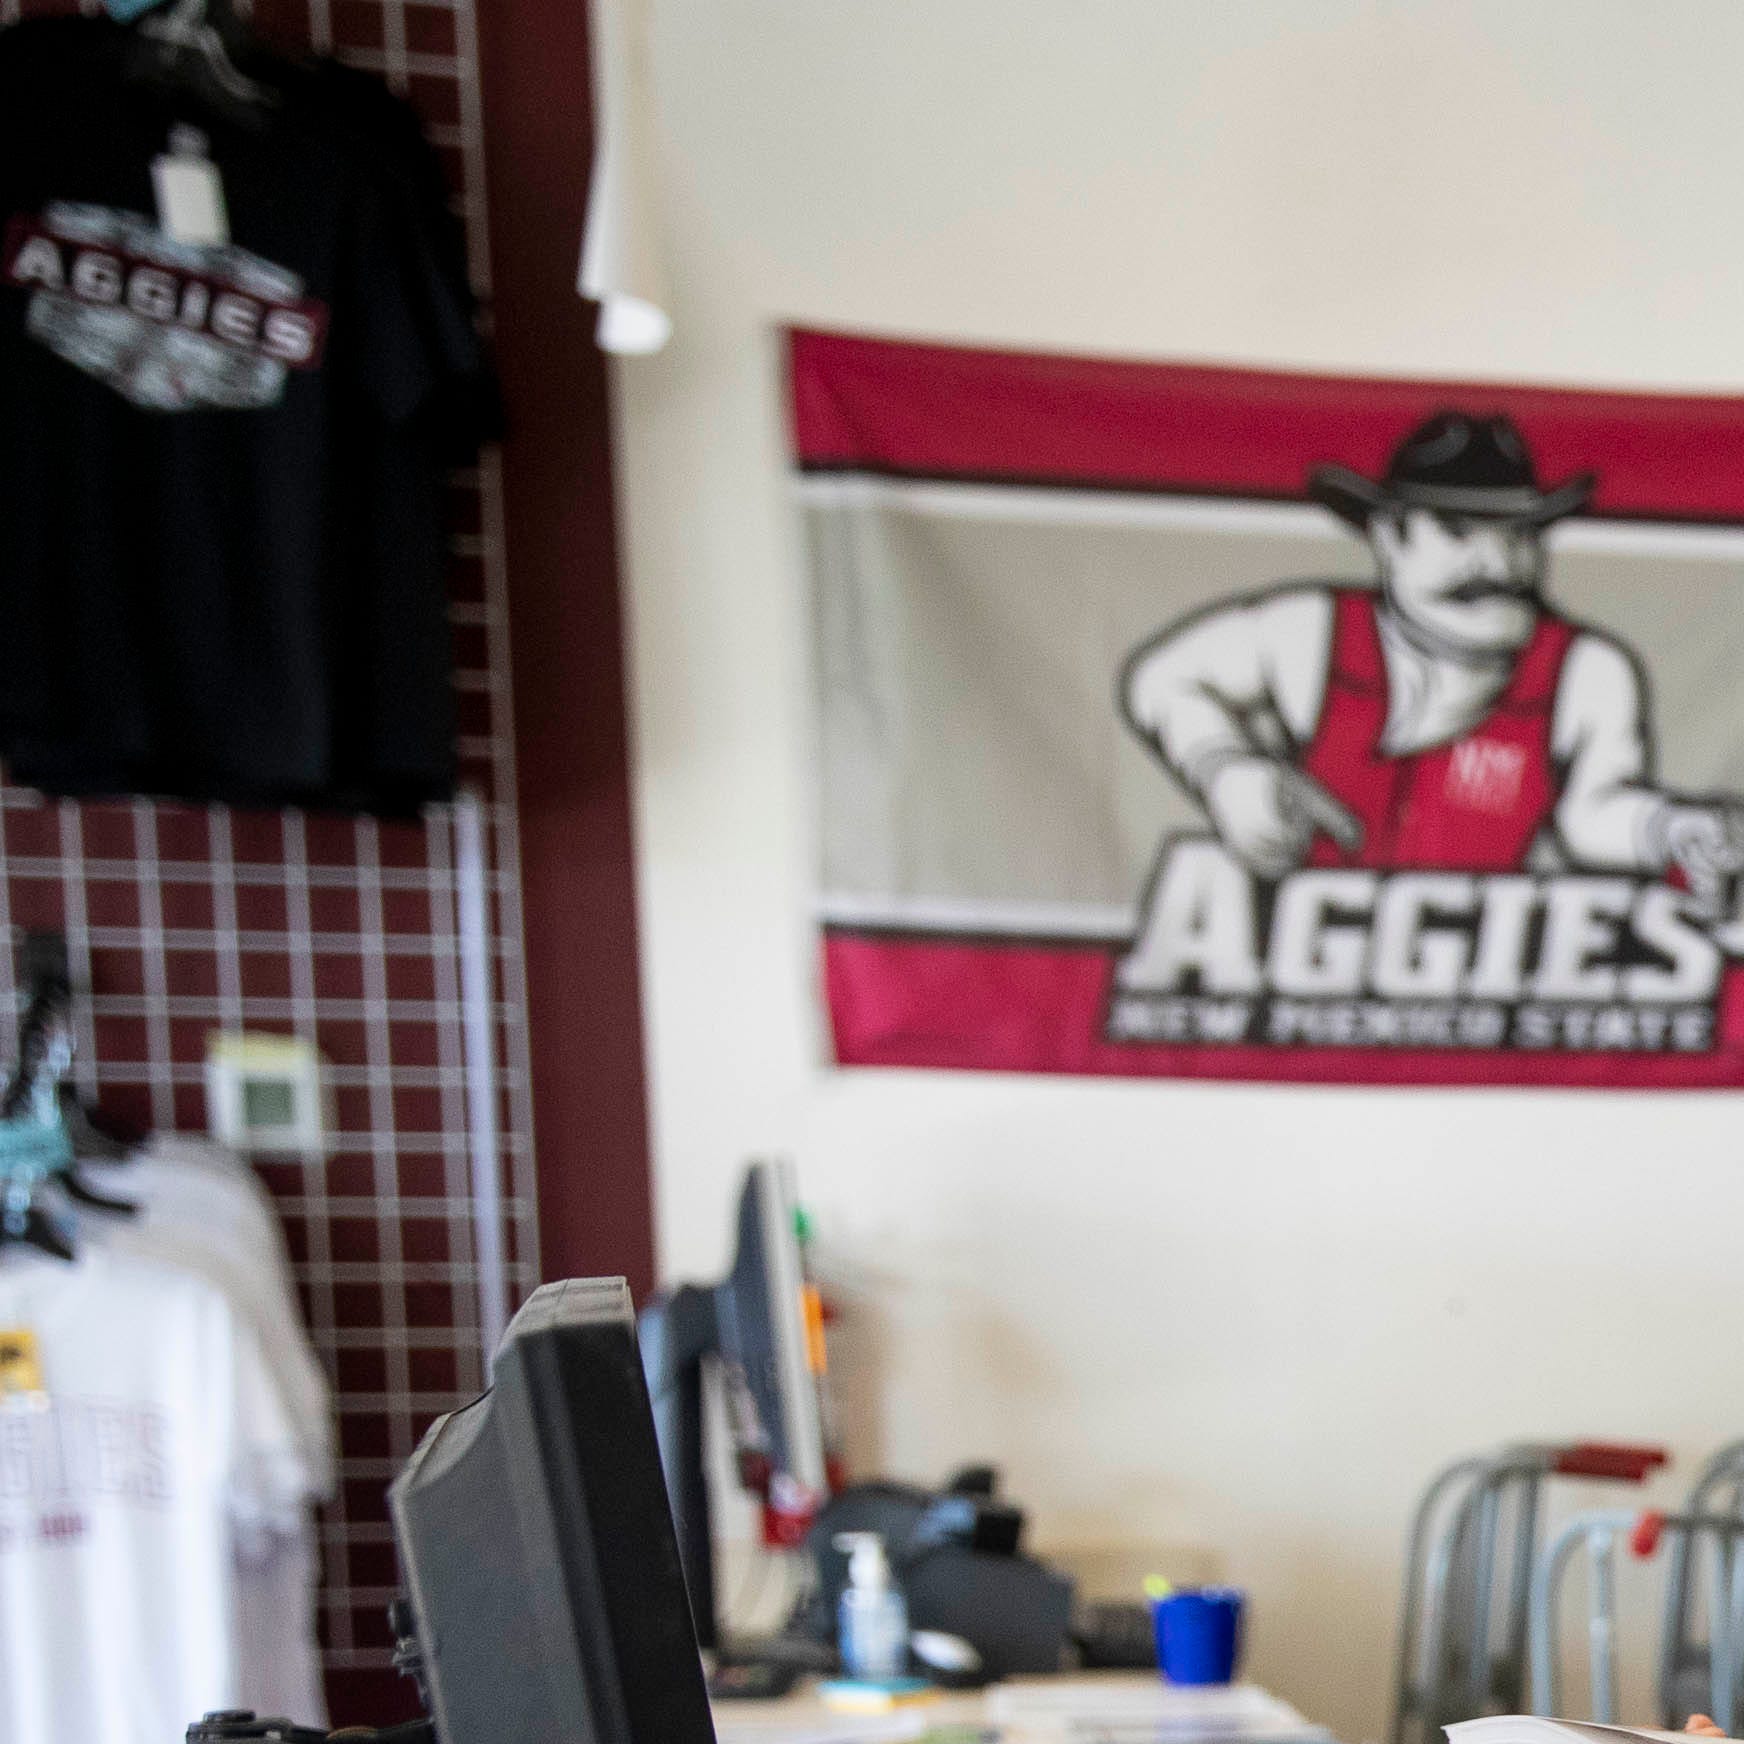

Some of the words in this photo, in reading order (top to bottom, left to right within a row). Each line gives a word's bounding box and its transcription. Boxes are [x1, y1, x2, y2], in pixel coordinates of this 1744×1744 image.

[11, 233, 314, 362] AGGIES
[1112, 838, 1723, 1001] AGGIES
[1108, 1001, 1251, 1042] NEW
[1266, 1003, 1505, 1046] MEXICO
[1513, 1006, 1715, 1052] STATE
